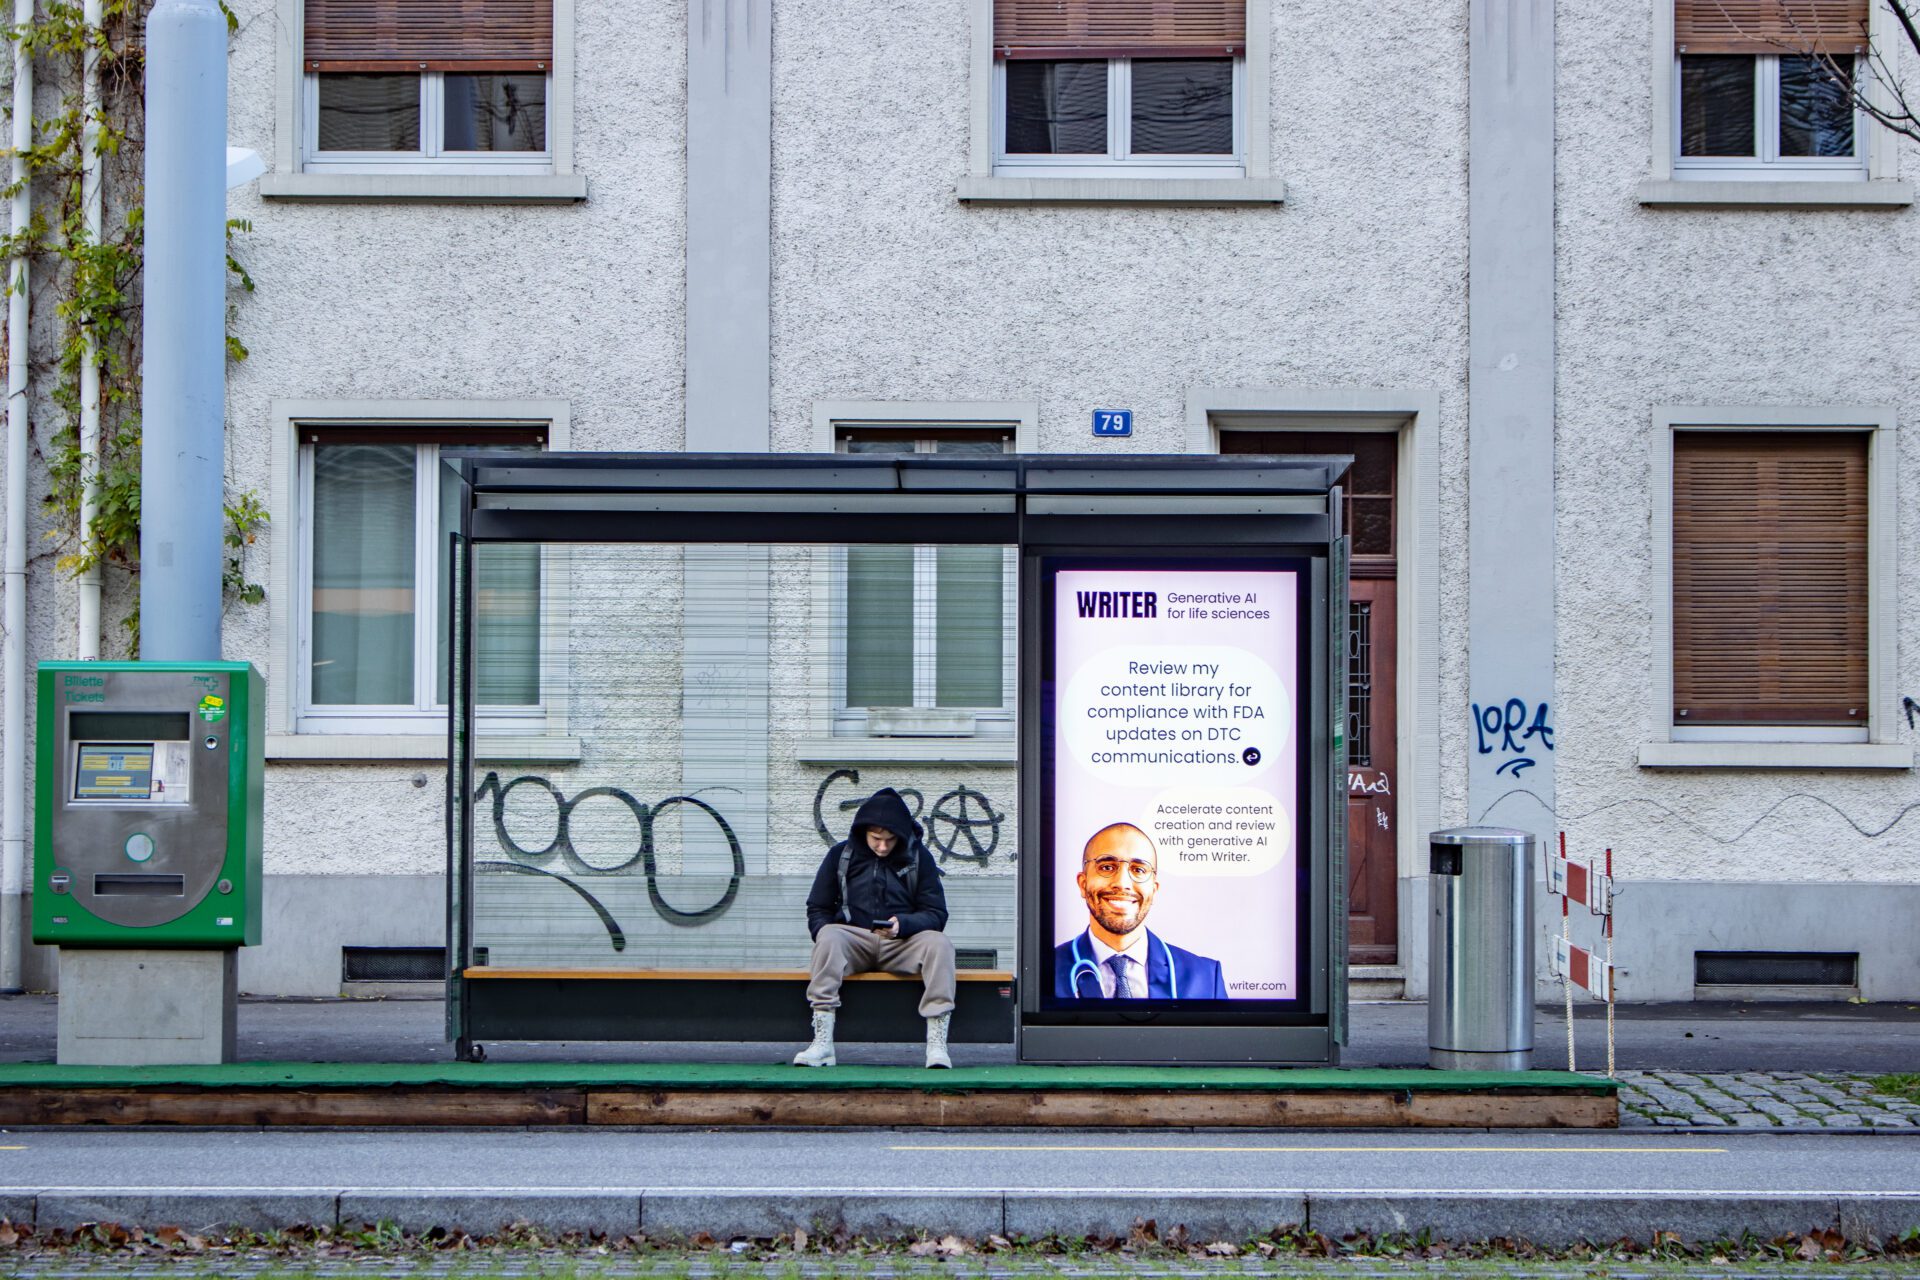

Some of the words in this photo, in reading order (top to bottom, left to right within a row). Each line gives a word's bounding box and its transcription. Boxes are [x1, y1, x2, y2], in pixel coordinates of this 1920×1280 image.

[1101, 414, 1123, 431] 79
[1076, 591, 1157, 618] WRITER
[1167, 592, 1241, 604] Generative
[1244, 592, 1257, 604] AI
[1167, 607, 1185, 619] for
[1188, 607, 1208, 619] life
[1211, 607, 1270, 620] sciences
[1129, 661, 1187, 675] Review
[1192, 664, 1220, 679] my
[64, 675, 104, 687] Billette
[64, 690, 104, 703] Tickets
[1100, 684, 1166, 697] content
[1171, 683, 1224, 701] library
[1229, 683, 1251, 697] for
[1087, 705, 1189, 722] compliance
[1193, 705, 1228, 719] with
[1233, 706, 1265, 719] FDA
[1472, 698, 1554, 754] LORA
[1106, 727, 1176, 744] updates
[1181, 730, 1203, 741] on
[1207, 728, 1241, 741] DTC
[1091, 750, 1239, 764] communications.
[1156, 804, 1223, 815] Accelerate
[1225, 804, 1273, 815] content
[1154, 820, 1205, 831] creation
[1207, 820, 1233, 831] and
[1235, 820, 1276, 831] review
[1158, 835, 1184, 846] with
[1186, 836, 1253, 849] generative
[1256, 836, 1268, 846] AI
[1179, 851, 1208, 862] from
[1211, 851, 1251, 862] Writer.
[1229, 981, 1287, 991] writer.com
